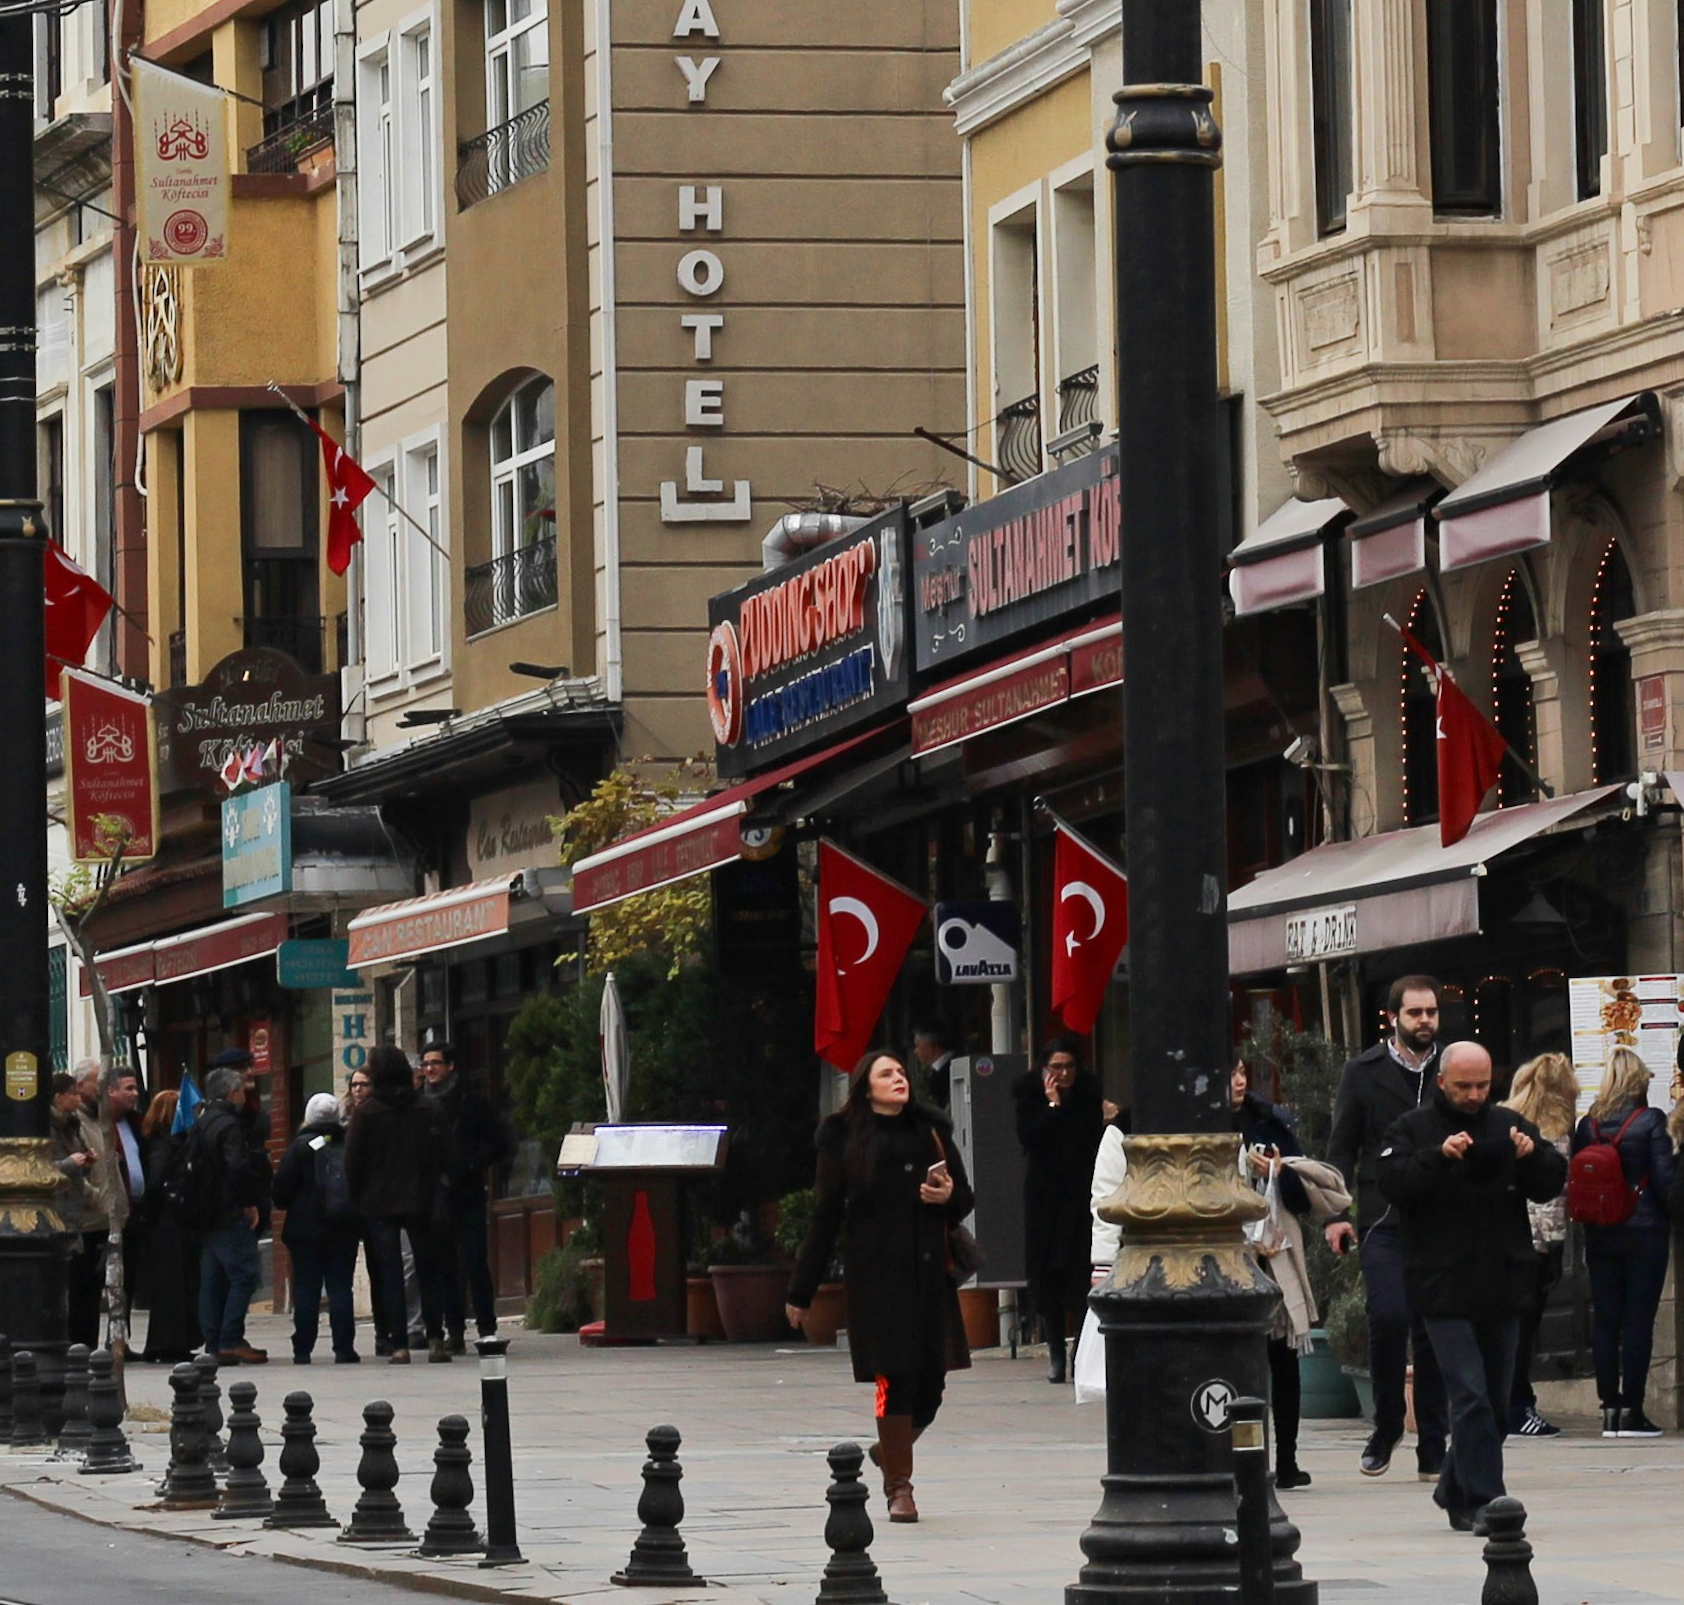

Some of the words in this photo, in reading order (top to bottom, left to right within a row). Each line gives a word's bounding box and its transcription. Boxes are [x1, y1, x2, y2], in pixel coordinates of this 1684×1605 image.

[150, 175, 218, 189] Sultanahmet
[676, 185, 724, 492] HOTEL
[969, 490, 1084, 620] SULTANAHMET
[740, 571, 811, 679] PUDDING
[810, 539, 872, 648] SHOP
[177, 691, 324, 734] Sultanahmet
[396, 901, 496, 948] RESTAURANT
